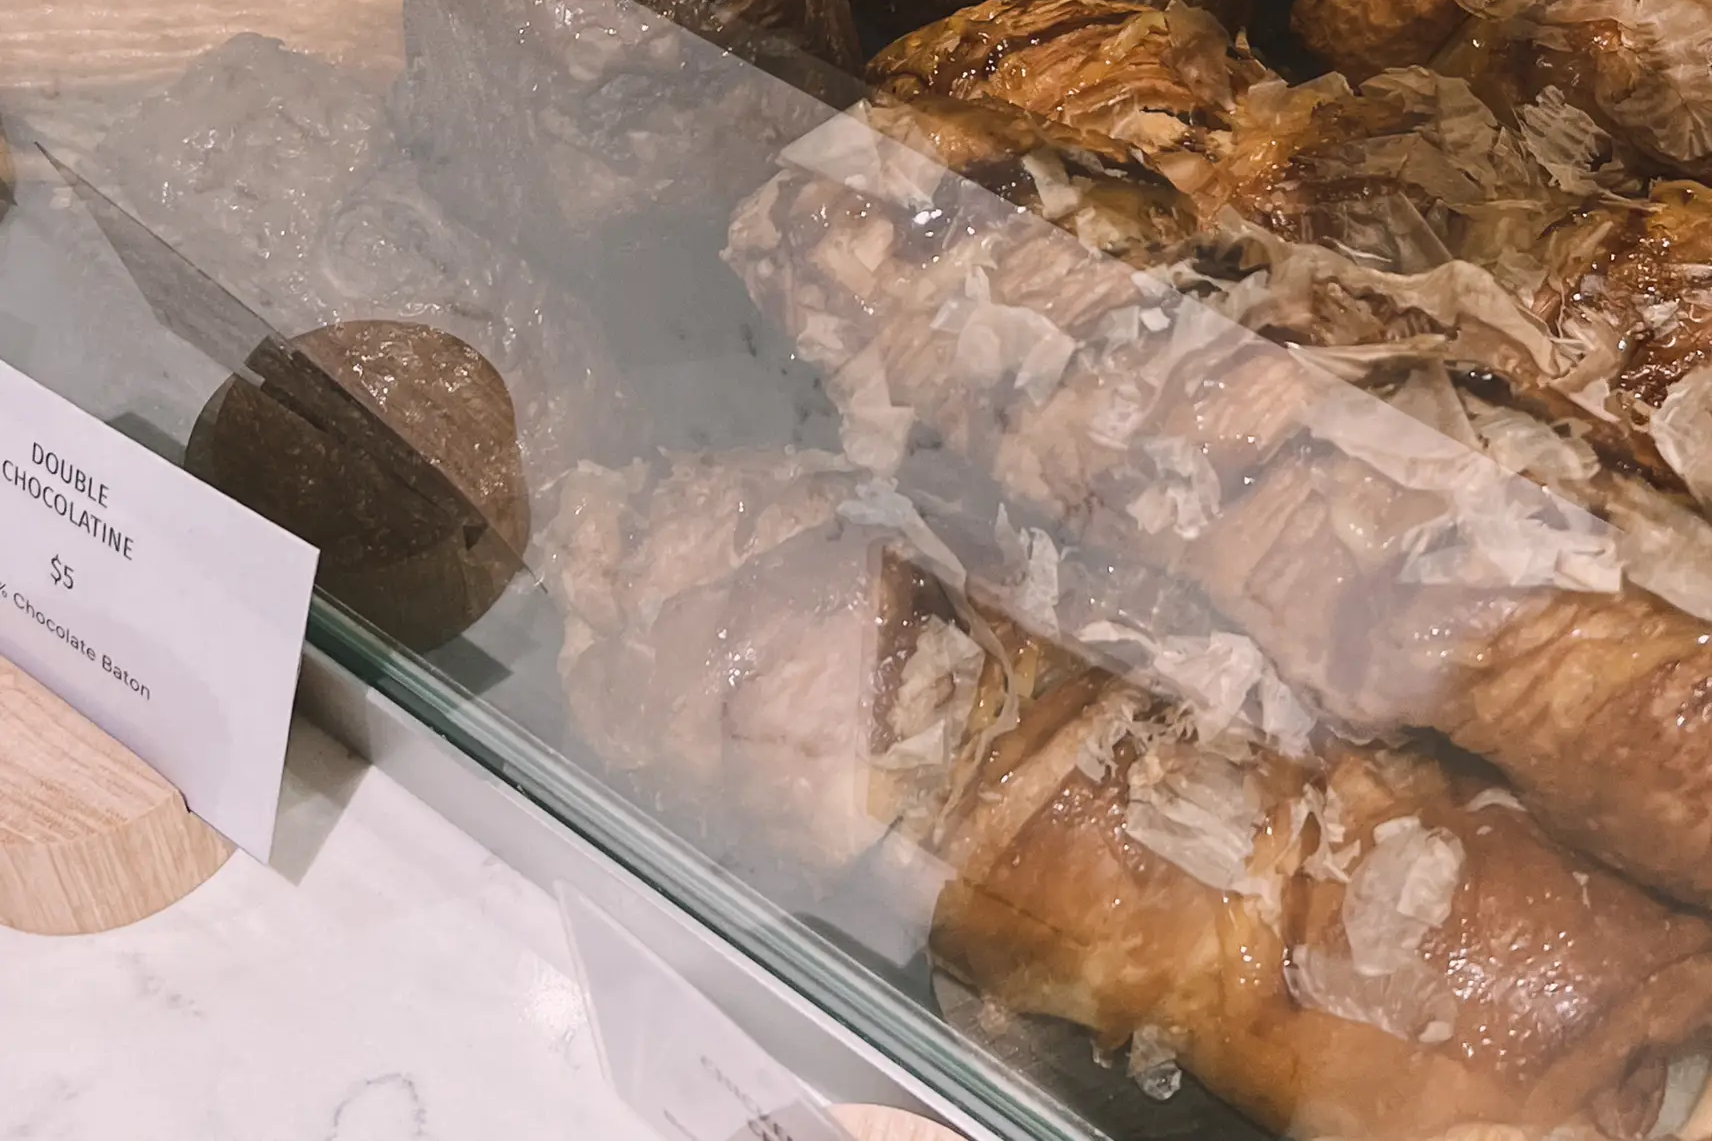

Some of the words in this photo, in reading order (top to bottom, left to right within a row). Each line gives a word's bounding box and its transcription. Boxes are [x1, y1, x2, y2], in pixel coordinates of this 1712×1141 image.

[1, 459, 135, 562] CHOCOLATINE
[31, 441, 110, 510] DOUBLE
[49, 553, 75, 591] $5
[12, 592, 97, 662] Chocolate
[101, 653, 152, 702] Baton
